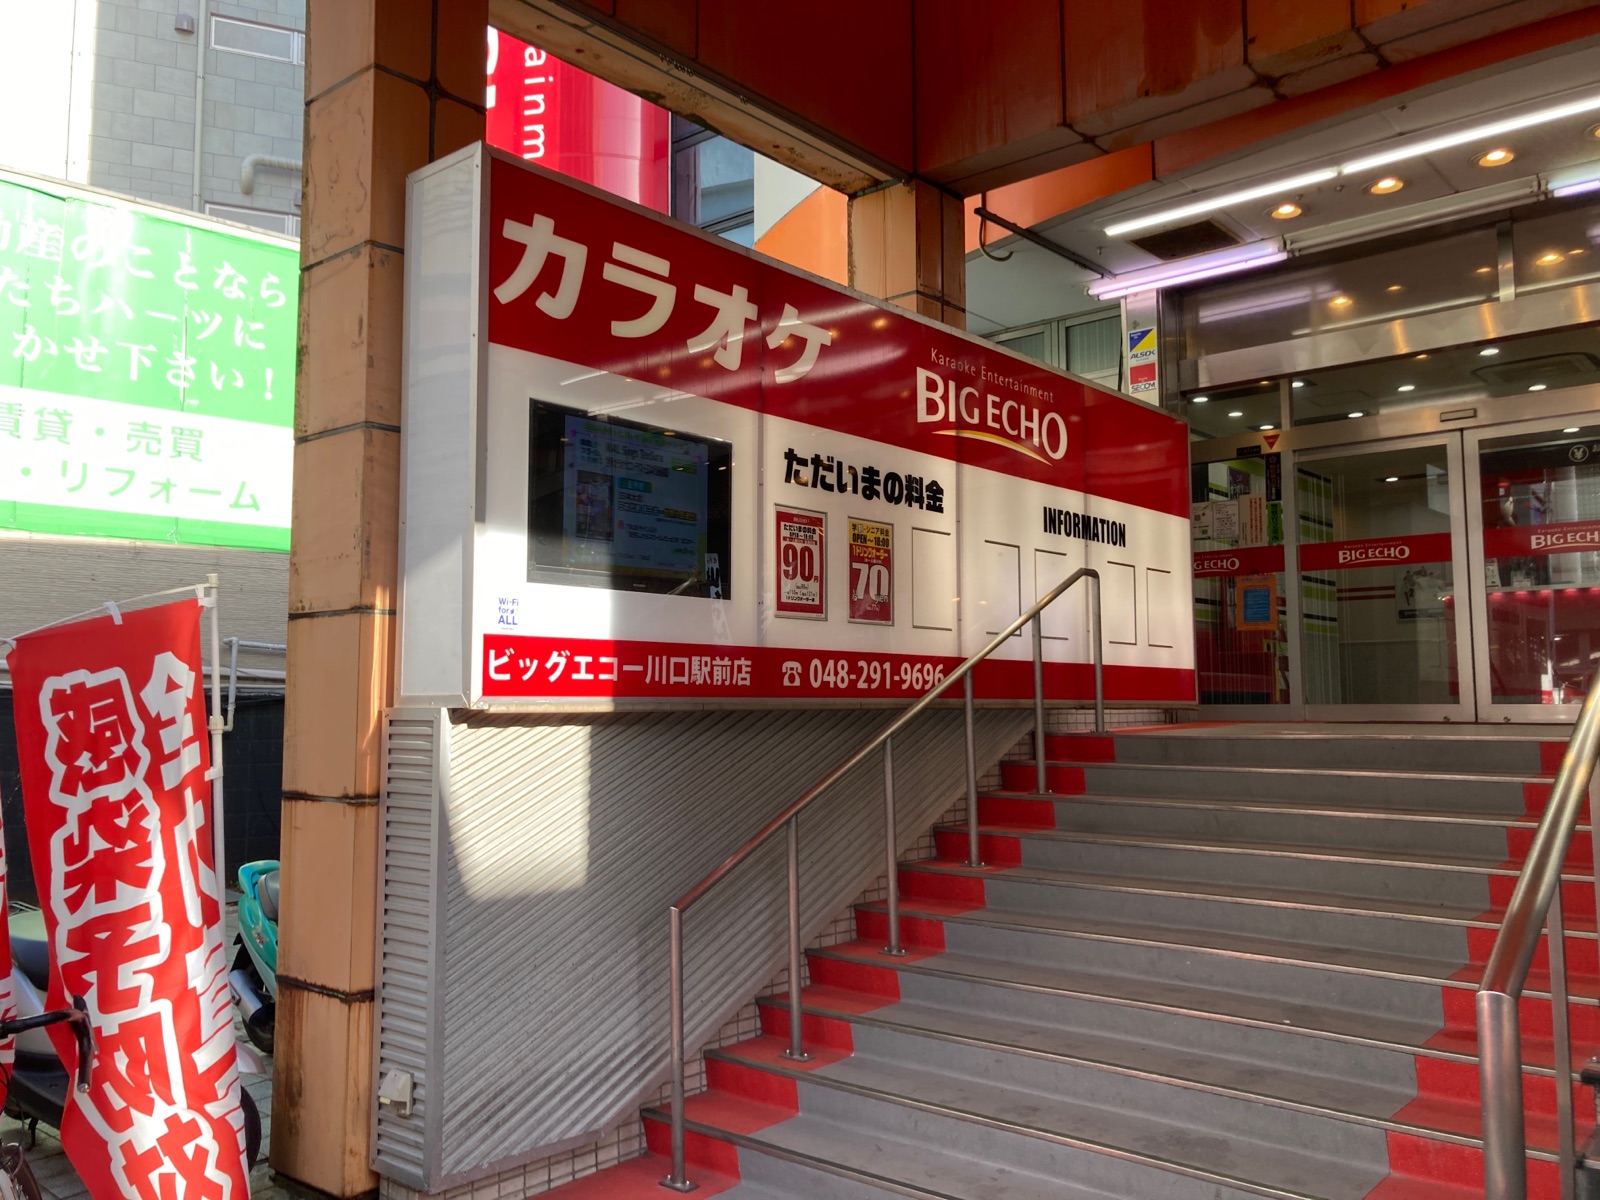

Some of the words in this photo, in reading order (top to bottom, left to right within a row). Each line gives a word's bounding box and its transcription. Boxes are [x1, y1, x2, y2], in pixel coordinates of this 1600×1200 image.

[493, 212, 833, 386] カラオケ
[930, 347, 977, 378] Karaoke
[980, 366, 1055, 404] Entertainment
[1131, 381, 1156, 392] SECOM
[916, 366, 980, 426] BIG
[986, 395, 1068, 461] ECHO
[783, 447, 945, 514] ただいまの料金
[1043, 505, 1127, 548] INFORMATION
[1530, 533, 1564, 550] BIG
[1204, 557, 1240, 570] ECHO
[1338, 549, 1366, 564] BIG
[1368, 545, 1411, 559] ECHO
[498, 597, 519, 606] Wi-Fi
[498, 615, 518, 625] ALL
[487, 646, 753, 687] ビッグエコー川口駅前店
[808, 658, 946, 692] 048-291-9696
